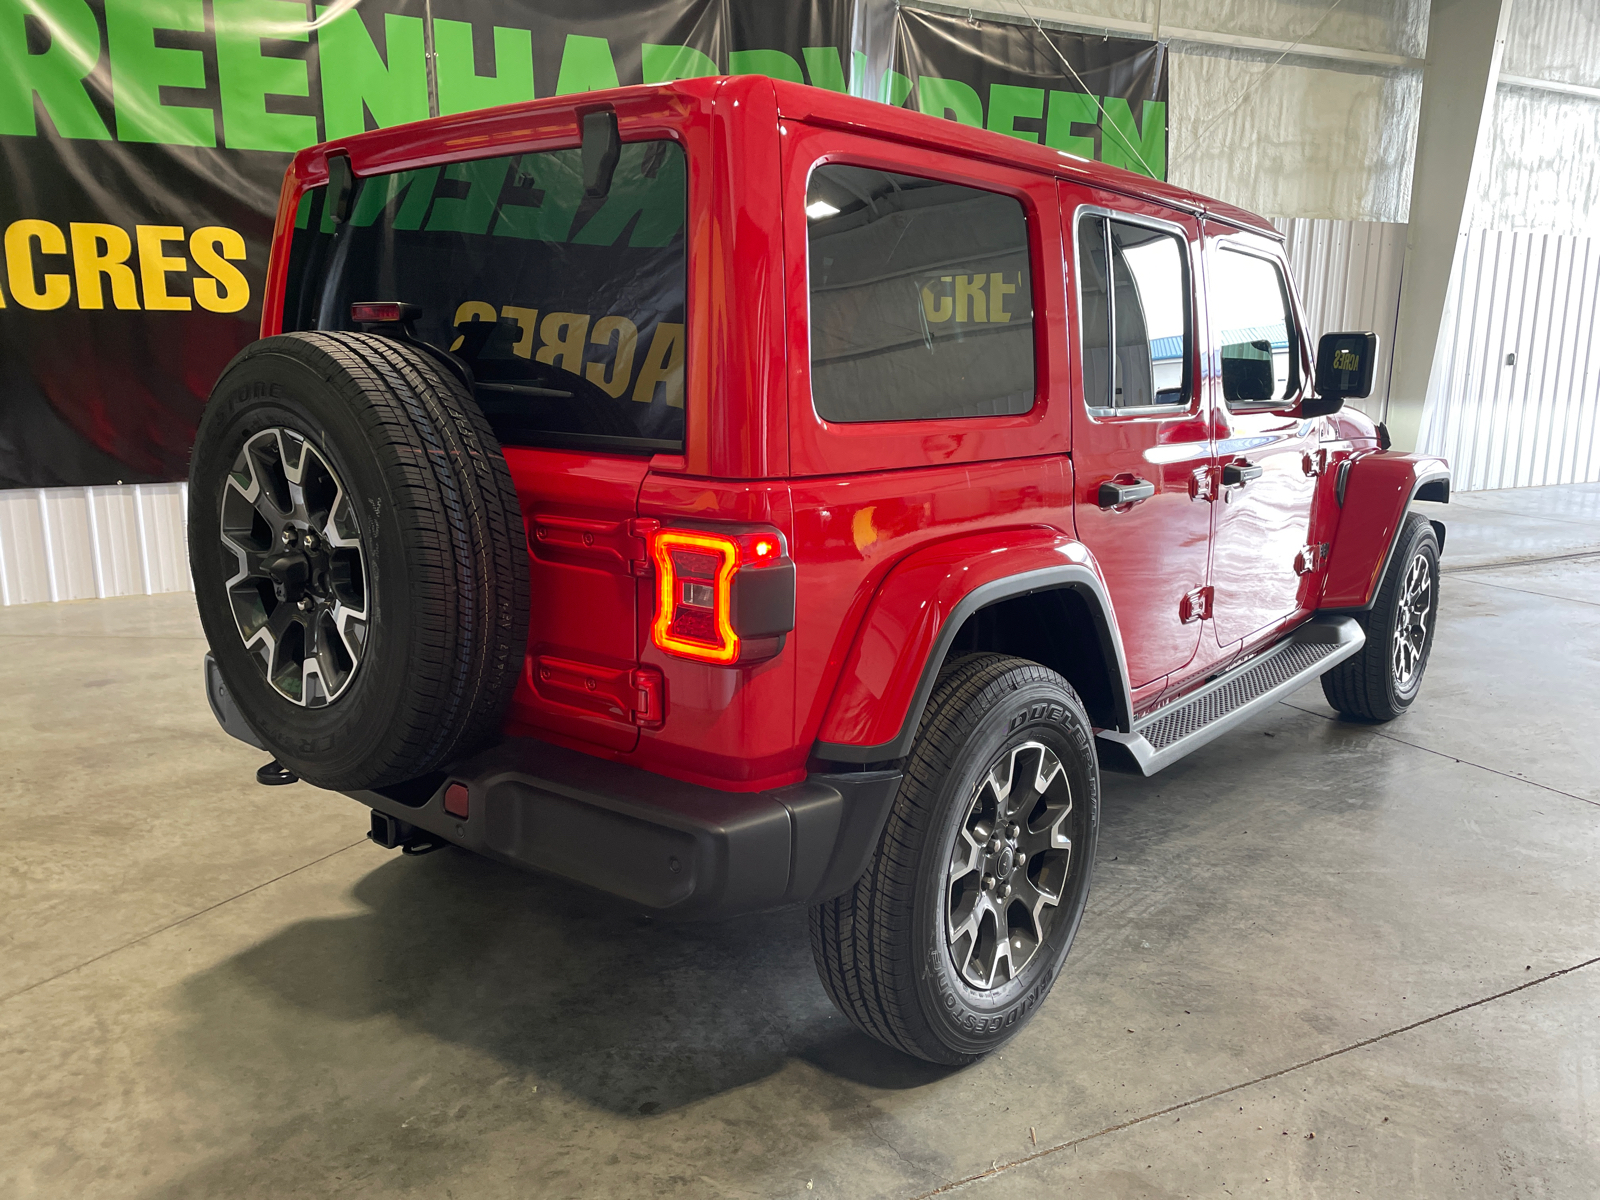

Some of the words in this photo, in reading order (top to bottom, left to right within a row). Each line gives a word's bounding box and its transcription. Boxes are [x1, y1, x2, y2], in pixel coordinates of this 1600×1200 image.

[878, 69, 1166, 182] REEN
[0, 218, 250, 313] CRES
[921, 270, 1022, 323] CRE
[1004, 702, 1094, 770] DUELER
[929, 948, 1056, 1035] BRIDGESTONE
